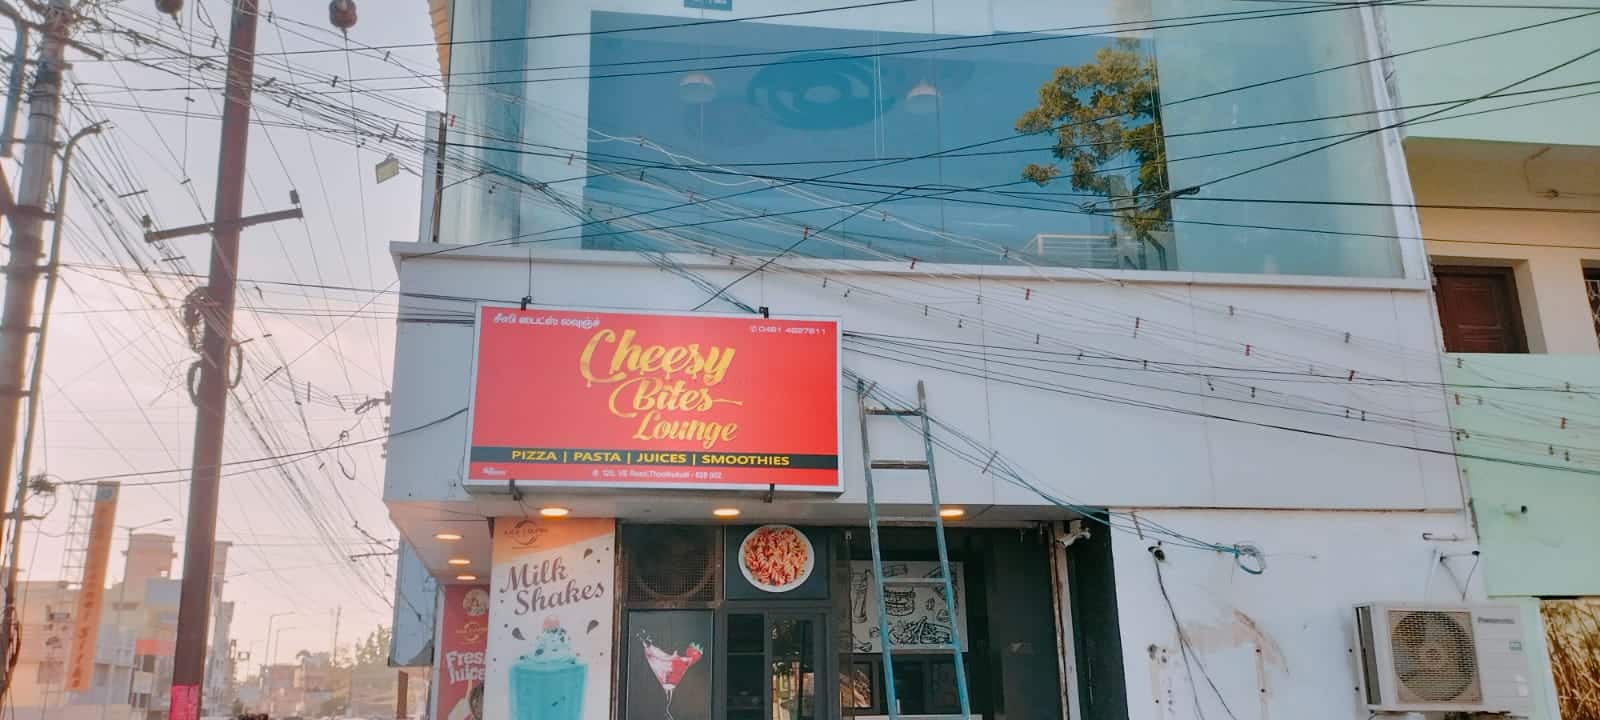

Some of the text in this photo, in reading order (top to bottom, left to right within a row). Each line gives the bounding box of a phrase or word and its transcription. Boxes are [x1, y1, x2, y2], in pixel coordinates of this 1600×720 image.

[579, 328, 736, 388] Cheesy
[608, 376, 744, 419] Bites
[632, 410, 737, 449] Lounge
[511, 450, 557, 461] PIZZA
[573, 452, 622, 462] PASTA
[637, 453, 687, 464] JUICES
[702, 454, 790, 466] SMOOTHIES
[500, 556, 567, 593] Milk
[514, 579, 604, 615] Shakes
[446, 650, 485, 669] Fres
